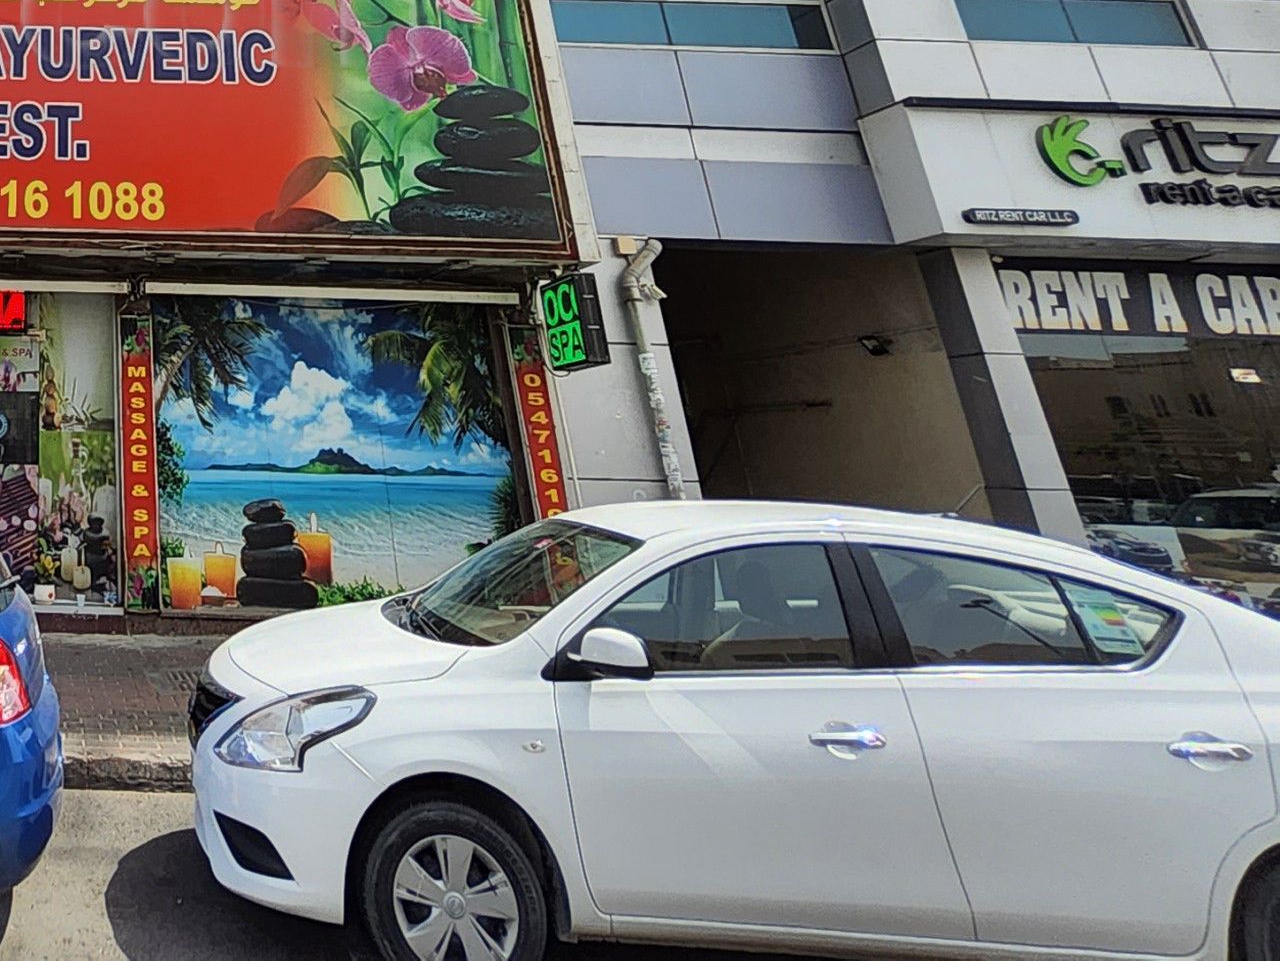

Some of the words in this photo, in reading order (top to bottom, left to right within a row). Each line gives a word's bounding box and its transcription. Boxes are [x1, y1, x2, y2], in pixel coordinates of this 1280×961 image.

[1120, 118, 1280, 177] ritz
[66, 181, 167, 222] 1088
[975, 209, 998, 222] RITZ
[998, 210, 1024, 222] RENT
[1025, 211, 1048, 223] CAR
[997, 269, 1131, 333] RENT
[1148, 272, 1189, 333] A
[11, 347, 33, 358] SPA
[549, 325, 586, 363] SPA
[127, 366, 149, 474] MASSAGE
[132, 484, 150, 497] &
[132, 509, 153, 558] SPA
